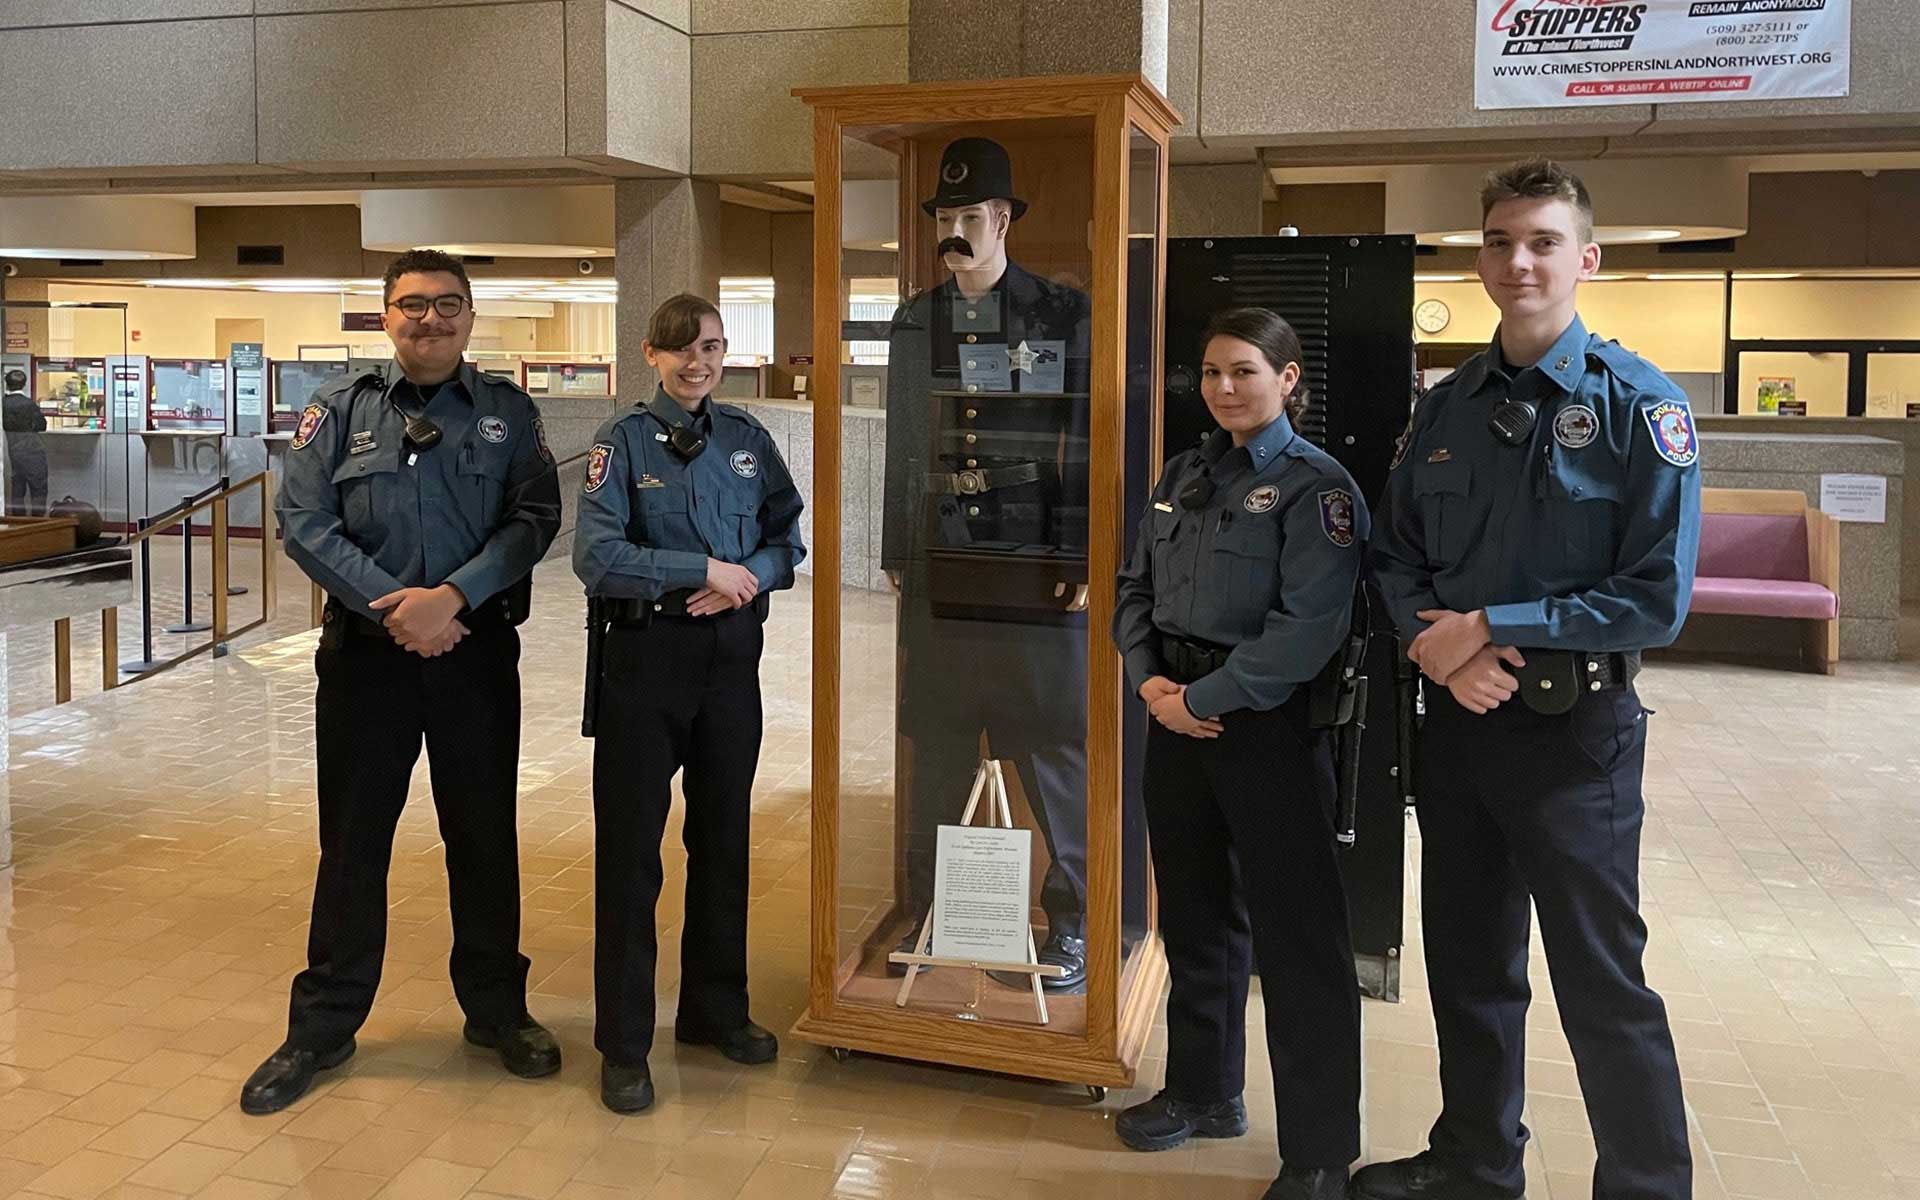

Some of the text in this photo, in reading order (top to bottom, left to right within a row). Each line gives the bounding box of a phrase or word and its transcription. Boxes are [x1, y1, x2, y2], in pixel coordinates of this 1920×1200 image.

[1692, 2, 1739, 14] REMAIN
[1508, 4, 1648, 37] STOPPERS
[1706, 22, 1810, 35] (509) 327-5111 or
[1522, 42, 1540, 53] The
[1540, 40, 1571, 52] Inland
[1571, 38, 1625, 51] Northwest
[1716, 33, 1800, 46] (800) 222-TIPS
[1572, 79, 1745, 94] CALL OR SUBMIT A WEBTIP ONLINE
[1651, 404, 1688, 421] SPOKANE
